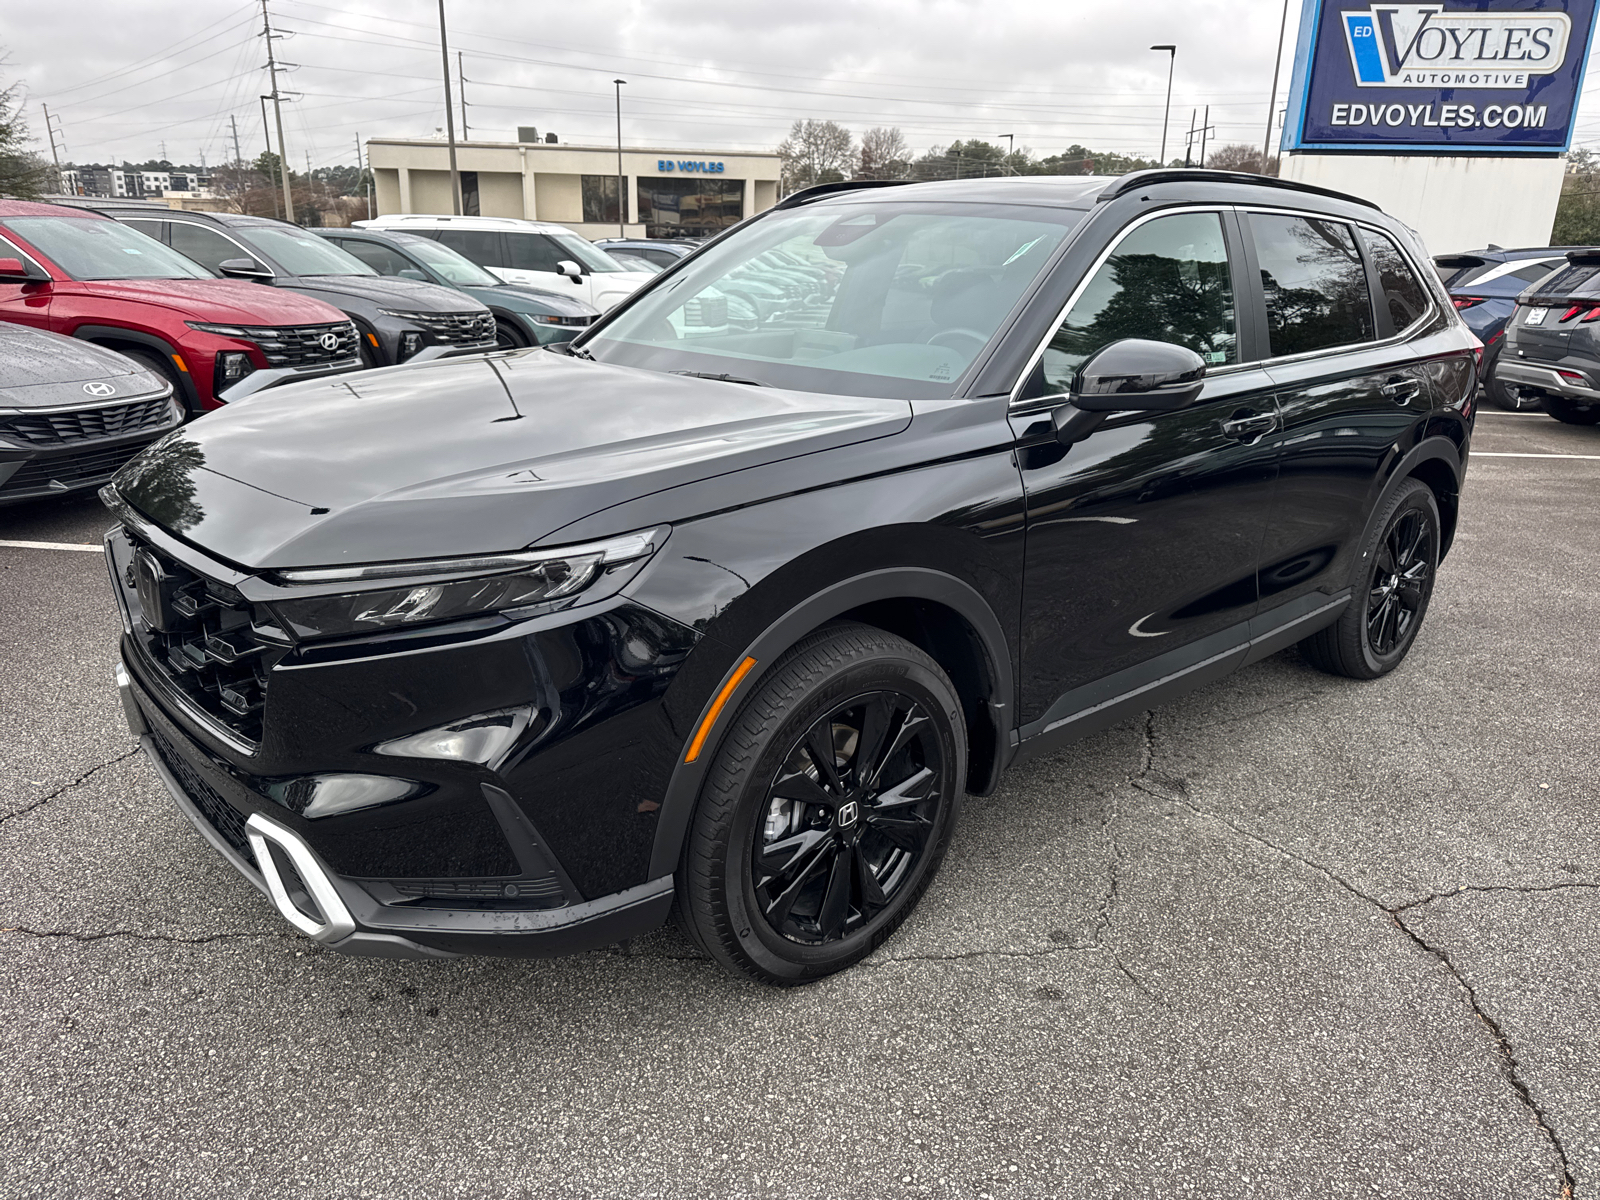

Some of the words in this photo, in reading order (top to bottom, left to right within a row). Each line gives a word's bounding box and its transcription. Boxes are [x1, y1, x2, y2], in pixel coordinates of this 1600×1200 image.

[1353, 26, 1372, 38] ED
[1376, 9, 1553, 76] VOYLES
[1403, 74, 1524, 84] AUTOMOTIVE
[1331, 104, 1547, 128] EDVOYLES.COM
[658, 160, 675, 172] ED
[677, 160, 725, 173] VOYLES
